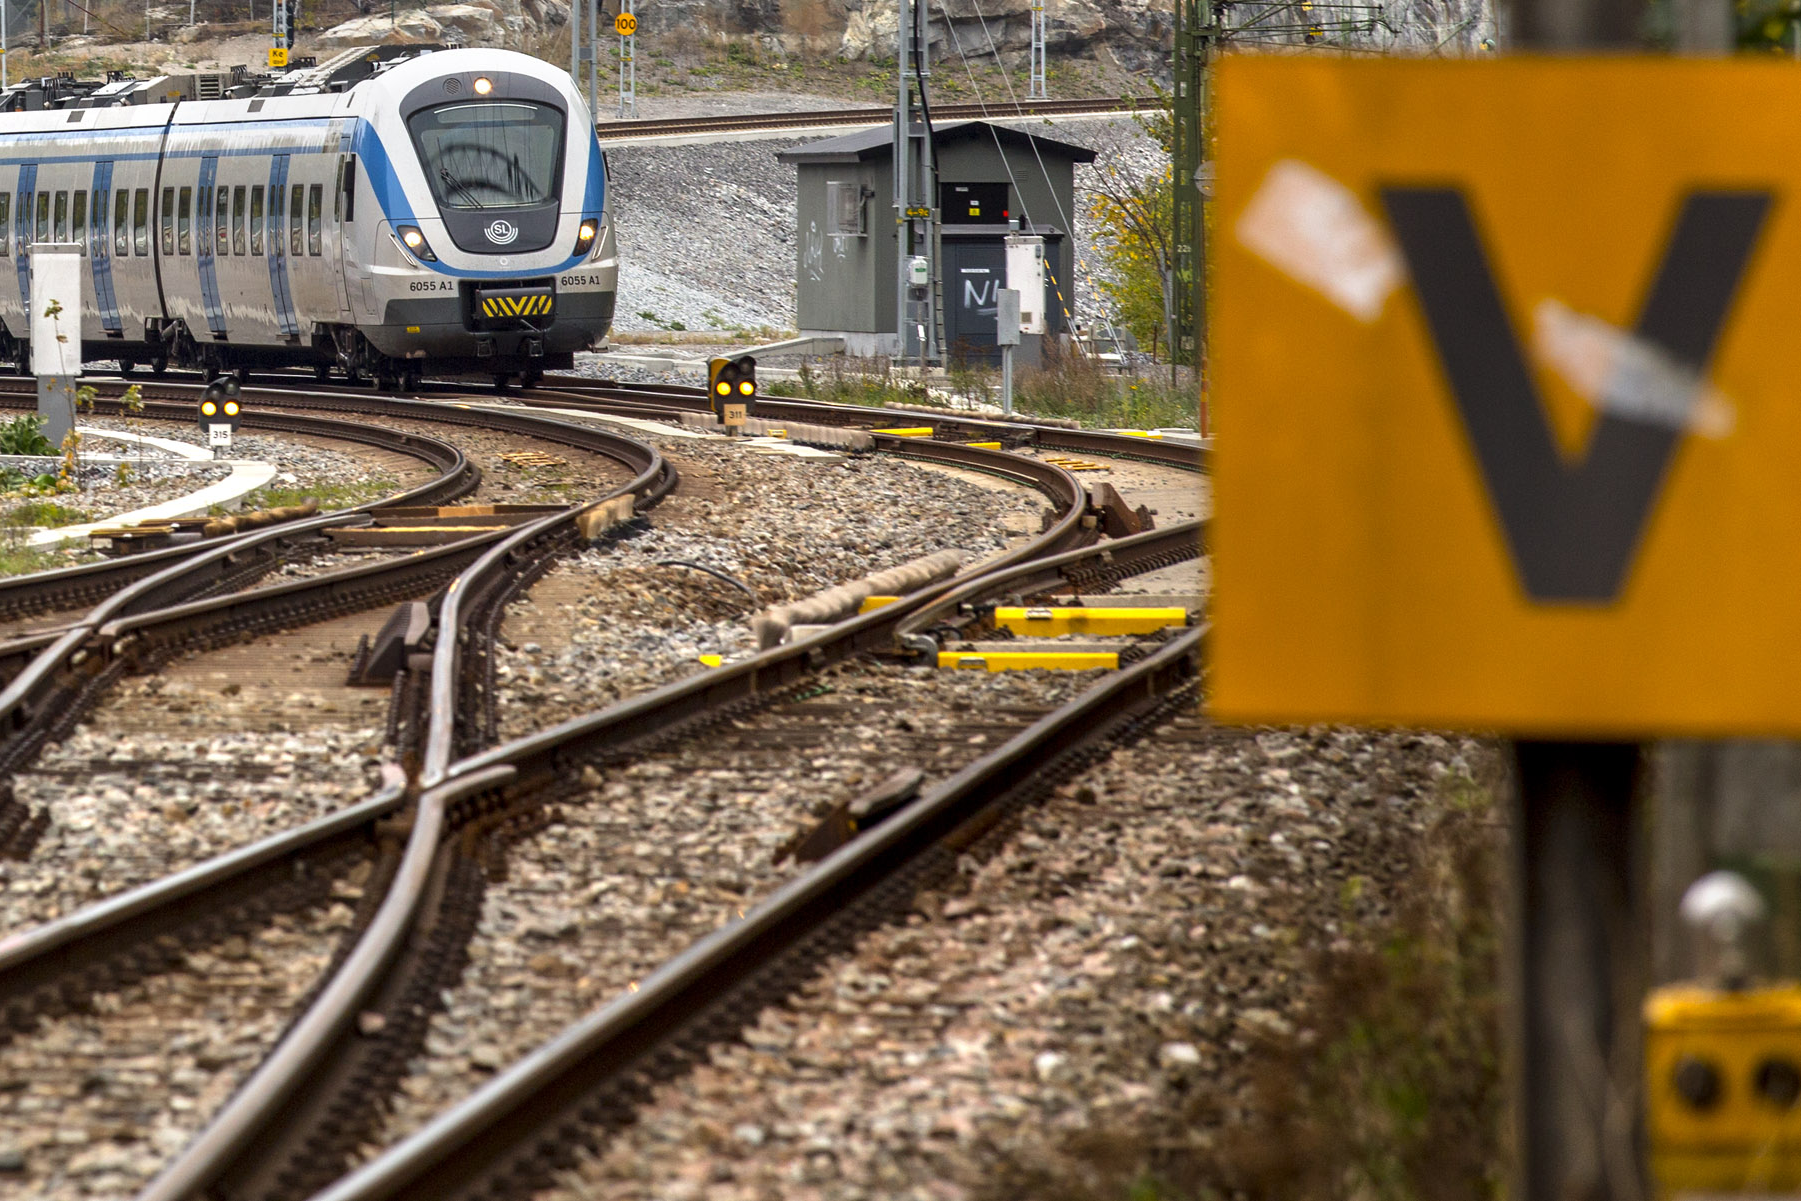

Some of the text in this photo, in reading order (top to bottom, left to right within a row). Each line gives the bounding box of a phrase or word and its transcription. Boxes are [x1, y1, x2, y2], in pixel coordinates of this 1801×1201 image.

[617, 19, 636, 29] 100
[494, 225, 508, 234] SL
[410, 281, 454, 291] 6055 A1
[561, 276, 601, 286] 6055 A1
[1375, 185, 1781, 604] V
[729, 411, 742, 419] 311
[213, 431, 229, 439] 315
